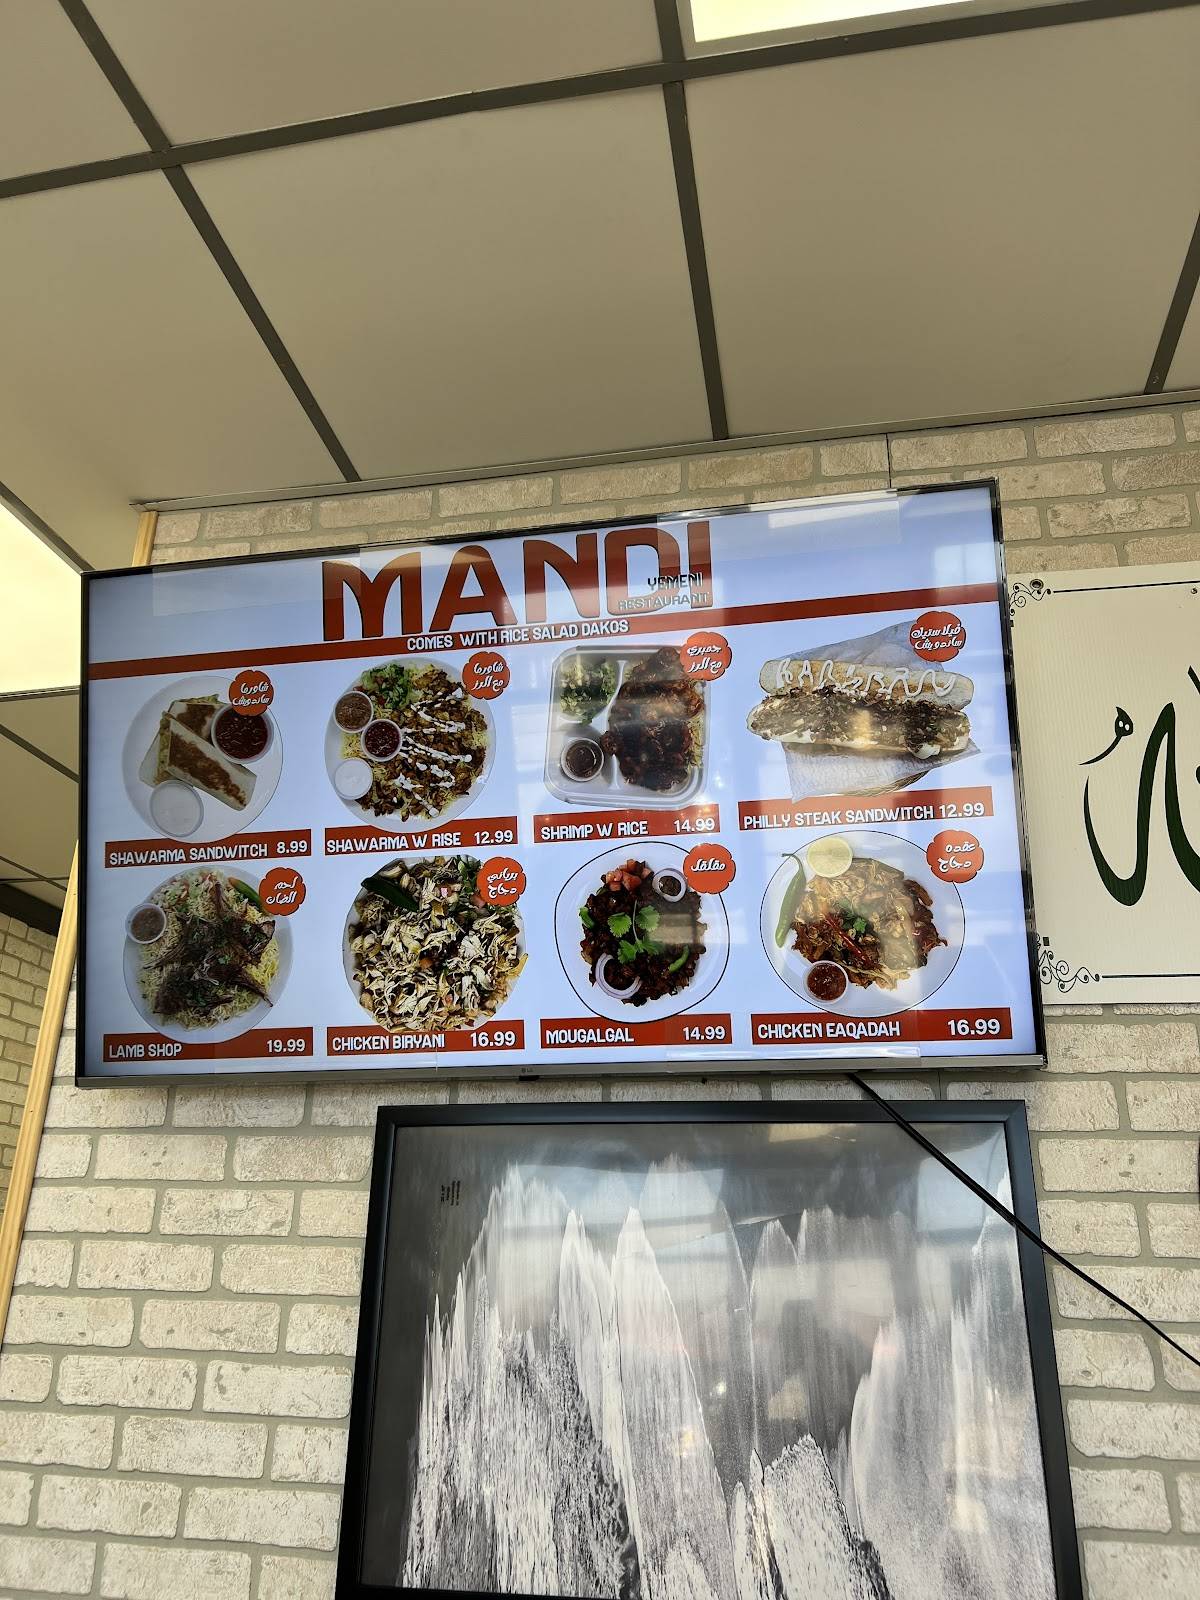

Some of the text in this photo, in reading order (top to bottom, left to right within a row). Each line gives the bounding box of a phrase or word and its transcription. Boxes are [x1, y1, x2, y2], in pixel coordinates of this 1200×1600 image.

[322, 521, 713, 641] MANDI
[647, 572, 703, 590] YEMENI
[618, 592, 709, 611] RESTAURANT
[407, 619, 629, 650] COMES WITH RICE SALAD DAKOS
[473, 661, 504, 676] شاورما
[687, 656, 723, 674] مع الرز
[240, 681, 270, 695] شاورما
[471, 675, 504, 692] مع الرز
[743, 802, 985, 830] PHILLY STEAK SANDWITCH 12.99
[540, 818, 716, 840] SHRIMP W RICE 14.99
[326, 829, 513, 853] SHAWARMA W RISE 12.99
[109, 840, 308, 866] SHAWARMA SANDWITCH 8.99
[274, 876, 299, 890] لحم
[487, 882, 517, 899] دجاج
[545, 1026, 726, 1044] MOUGALGAL 14.99
[757, 1019, 1001, 1040] CHICKEN EAQADAH 16.99
[109, 1039, 306, 1059] LAMB SHOP 19.99
[332, 1031, 516, 1051] CHICKEN BIRYANI 16.99
